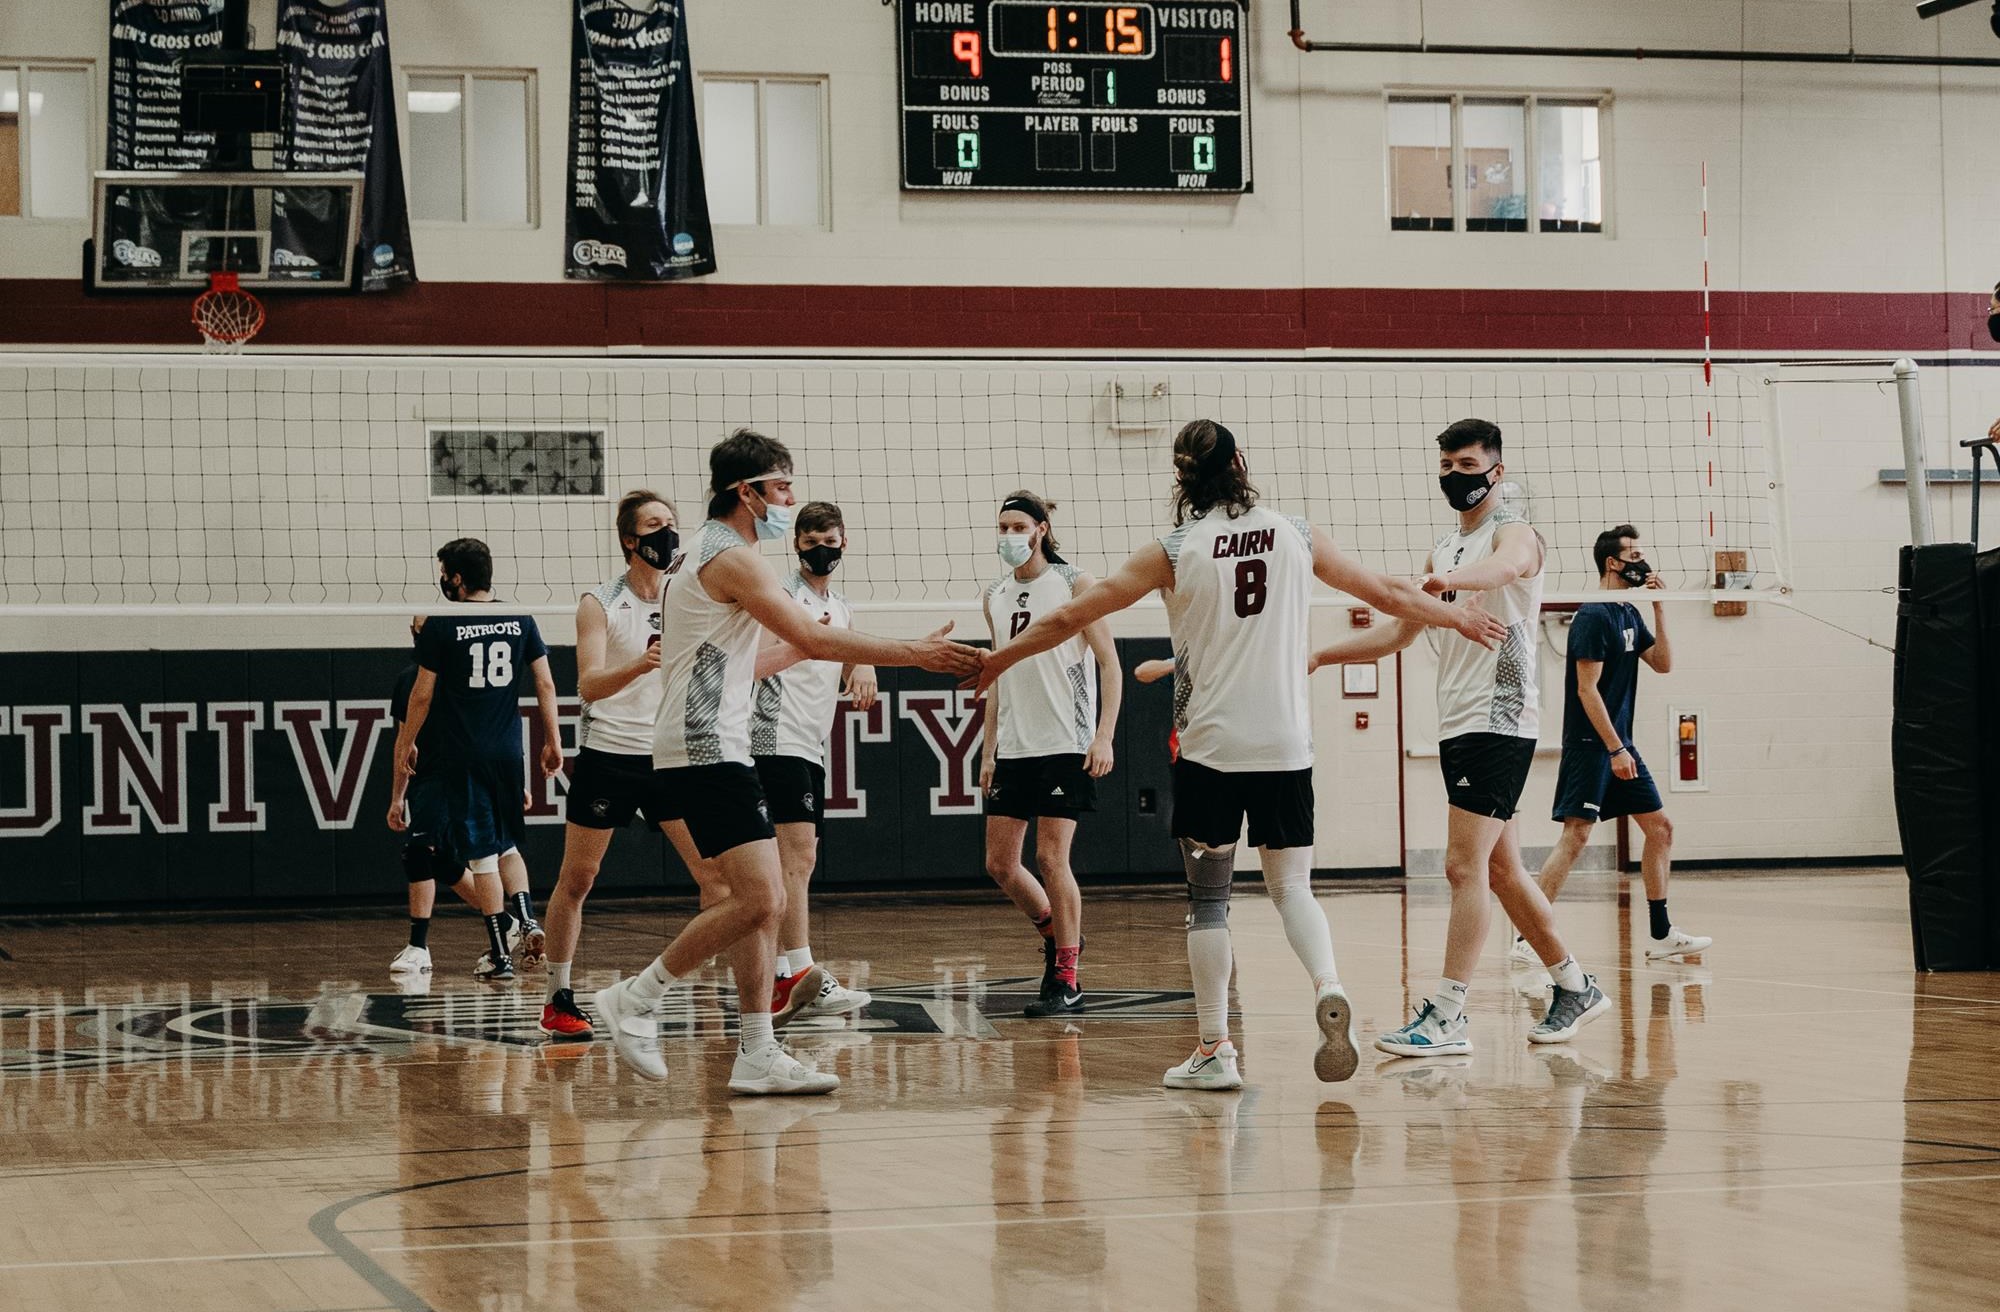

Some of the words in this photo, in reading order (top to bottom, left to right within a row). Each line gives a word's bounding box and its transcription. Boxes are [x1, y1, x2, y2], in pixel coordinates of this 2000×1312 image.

[916, 1, 975, 24] HOME
[1157, 8, 1235, 29] VISITOR
[112, 23, 147, 44] MEN'S
[149, 33, 191, 49] CROSS
[1047, 6, 1144, 54] 1:15
[318, 43, 357, 60] CROSS
[953, 31, 981, 79] 9
[1220, 37, 1231, 82] 1
[1043, 62, 1072, 74] POSS
[625, 78, 650, 91] Bible
[1031, 75, 1085, 92] PERIOD
[1106, 70, 1115, 105] 1
[136, 88, 159, 99] Cairn
[616, 92, 661, 105] University
[940, 85, 990, 101] BONUS
[1157, 88, 1206, 105] BONUS
[136, 102, 180, 114] Rosemont
[932, 114, 979, 130] FOULS
[1025, 116, 1079, 132] PLAYER
[1091, 117, 1138, 133] FOULS
[1169, 118, 1215, 134] FOULS
[134, 131, 176, 142] Neumann
[600, 127, 621, 141] Cairn
[133, 146, 165, 157] Cabrini
[601, 142, 621, 155] Cairn
[956, 133, 978, 168] 0
[1193, 136, 1214, 171] 0
[601, 156, 621, 169] Cairn
[942, 171, 973, 186] WON
[1177, 174, 1208, 188] WON
[1212, 528, 1276, 559] CAIRN
[1234, 559, 1267, 619] 8
[456, 621, 522, 641] PATRIOTS
[469, 641, 513, 688] 18
